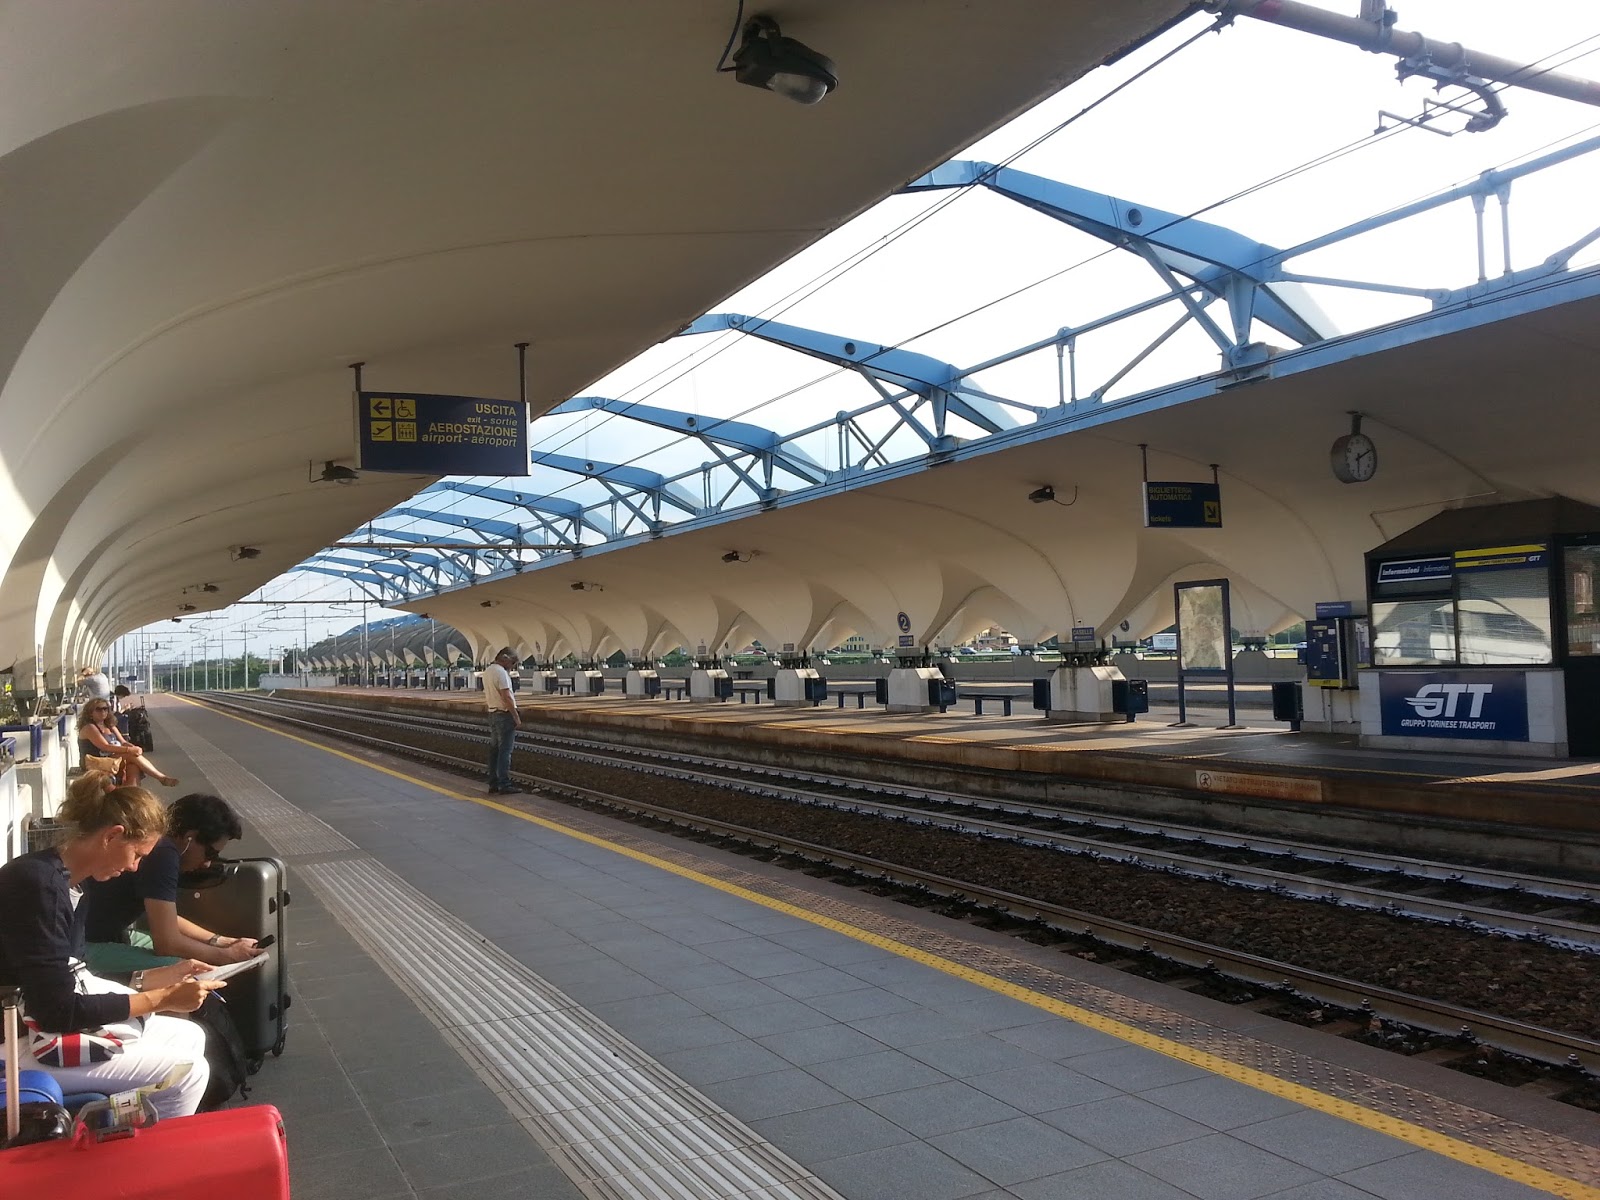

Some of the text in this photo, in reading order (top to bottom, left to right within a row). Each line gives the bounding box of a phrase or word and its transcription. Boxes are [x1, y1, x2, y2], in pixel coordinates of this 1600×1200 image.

[475, 403, 516, 416] USCITA
[467, 416, 481, 424] exit
[490, 417, 518, 426] sortie
[429, 423, 517, 437] AEROSTAZIONE
[422, 433, 462, 444] airport
[471, 435, 516, 447] aéroport
[1382, 566, 1420, 576] Informazioni
[900, 616, 908, 629] 2
[1405, 683, 1494, 718] GTT
[1401, 719, 1496, 730] GRUPPO TORINESE TRASPORTI
